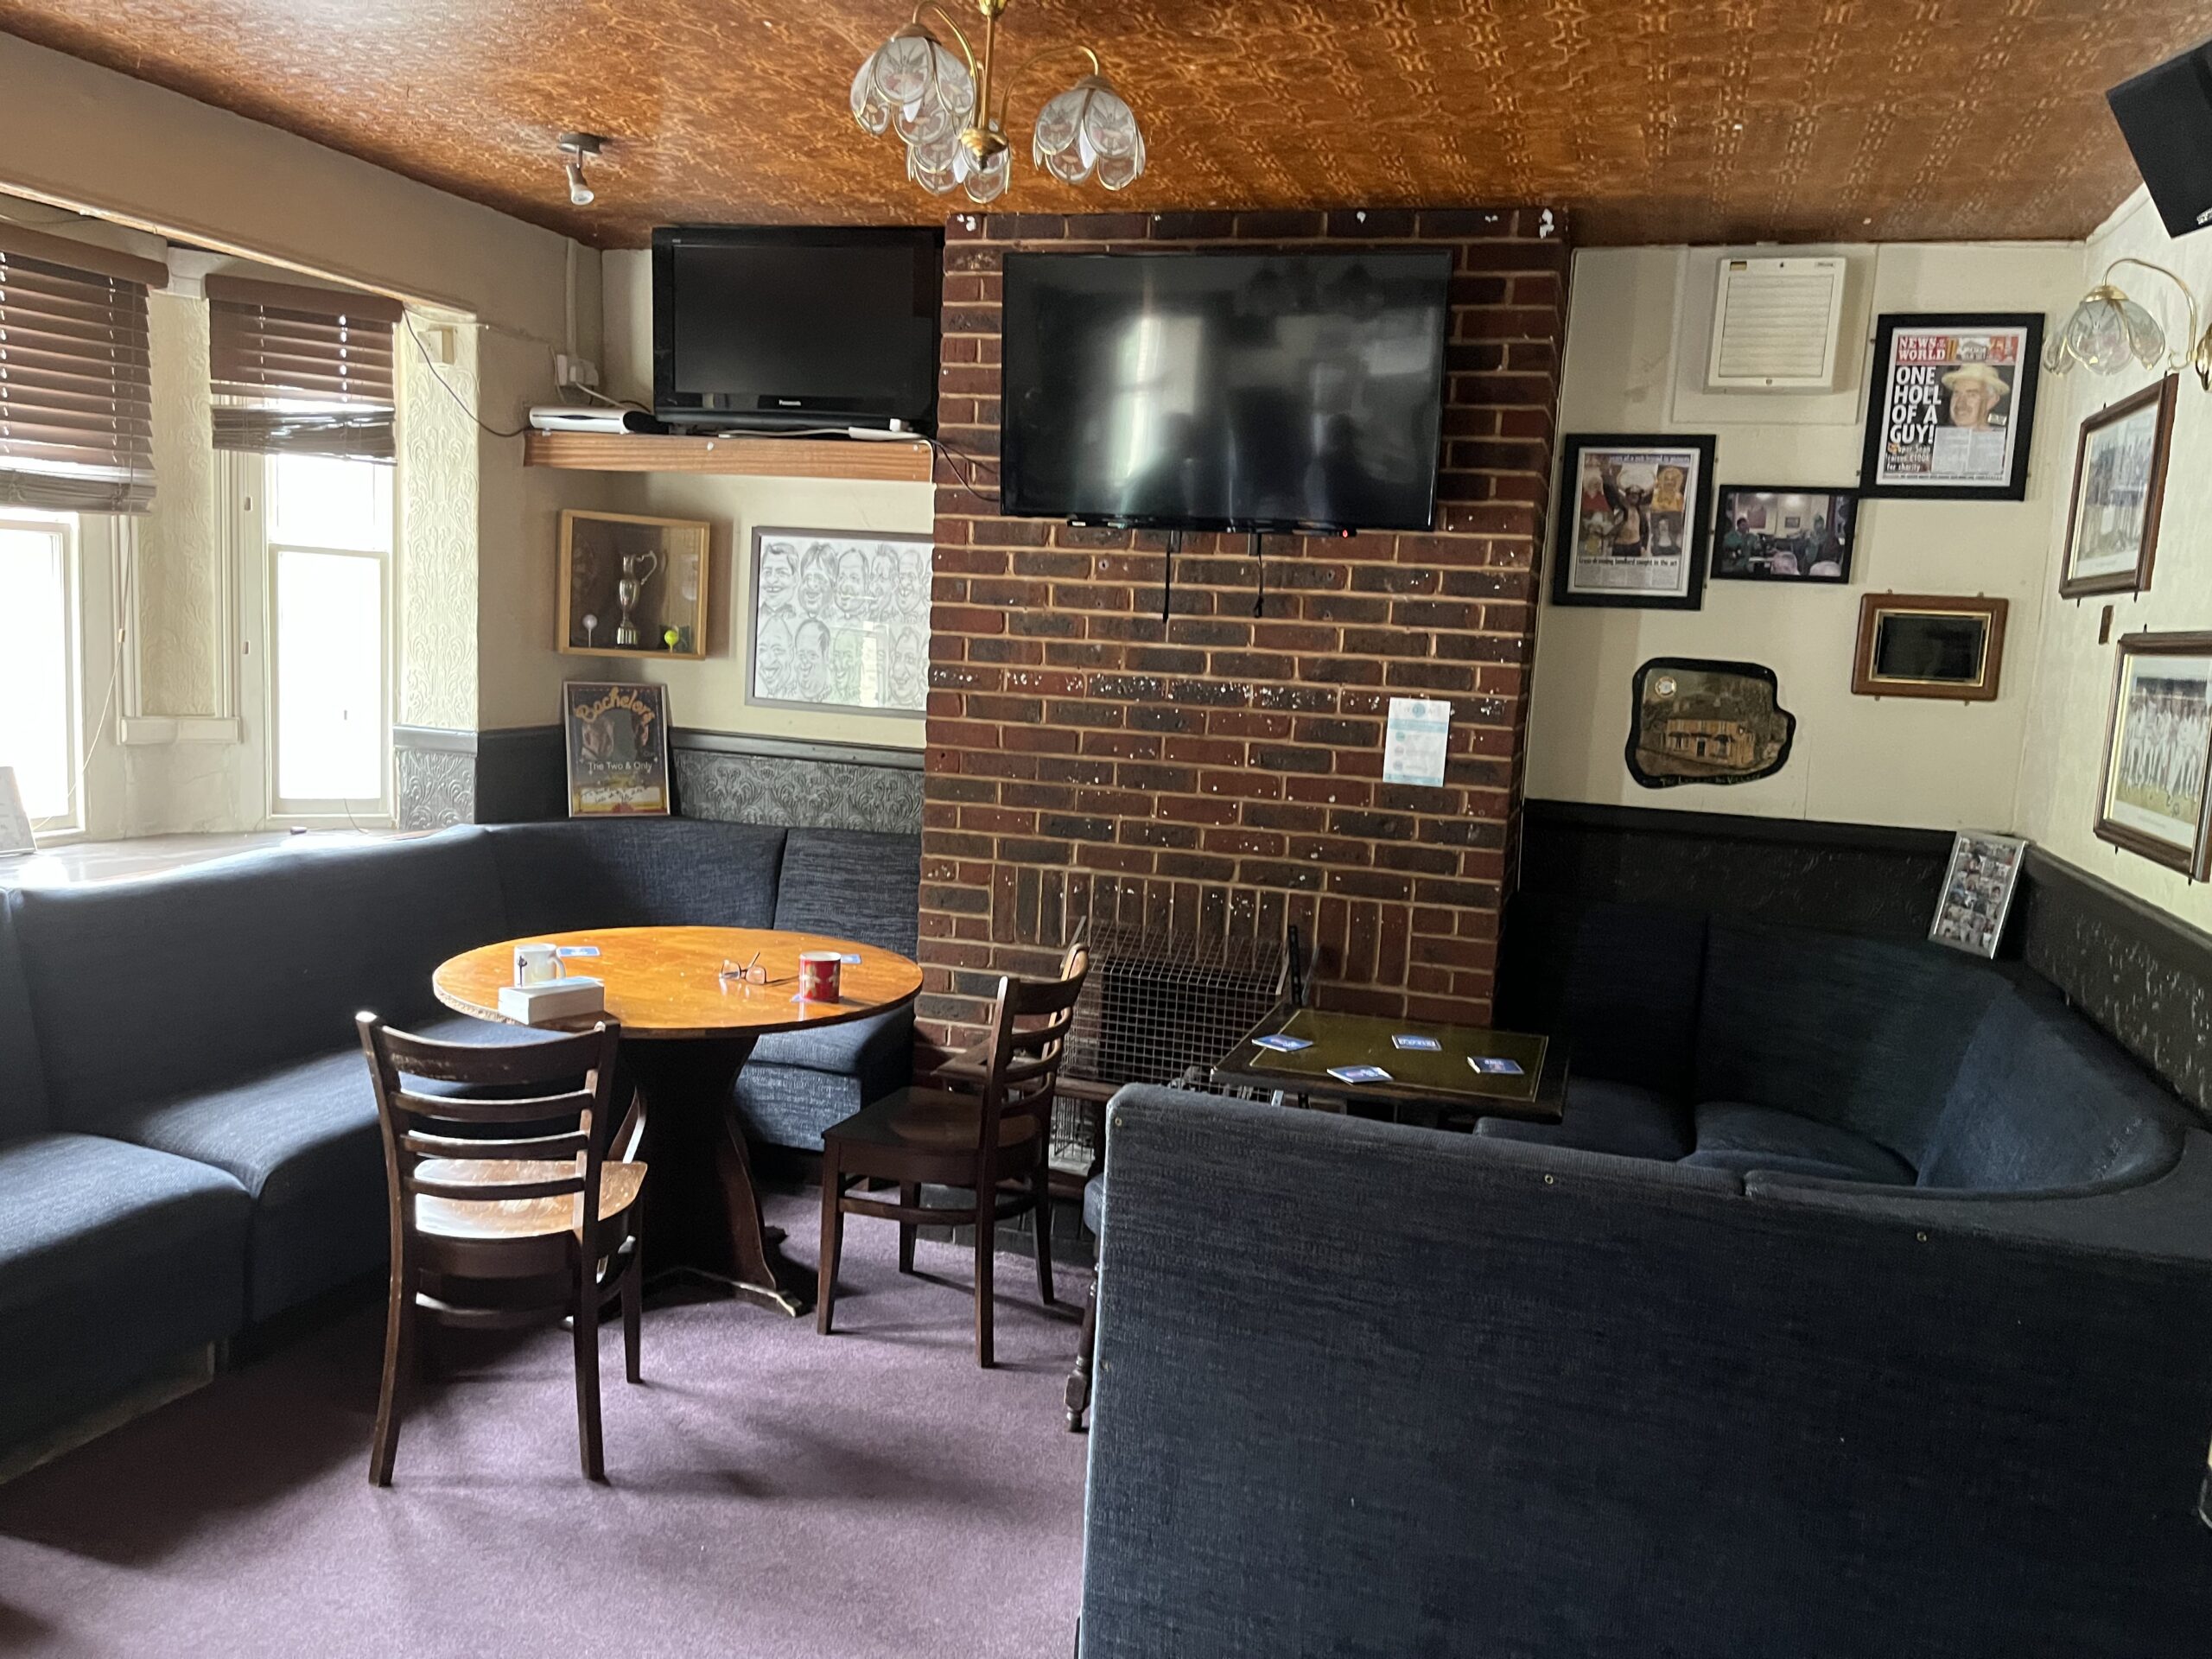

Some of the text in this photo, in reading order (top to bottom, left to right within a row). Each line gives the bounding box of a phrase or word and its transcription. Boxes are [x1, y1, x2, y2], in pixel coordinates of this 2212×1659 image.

[1898, 335, 1936, 349] NEWS
[1898, 349, 1946, 361] WORLD
[1896, 366, 1936, 385] ONE
[1894, 385, 1942, 405] HOLL
[1891, 405, 1938, 425] OF A
[1890, 424, 1935, 444] GUY!
[575, 686, 656, 722] Bachelors
[607, 761, 623, 770] Two
[625, 761, 632, 770] &
[633, 761, 652, 772] Only
